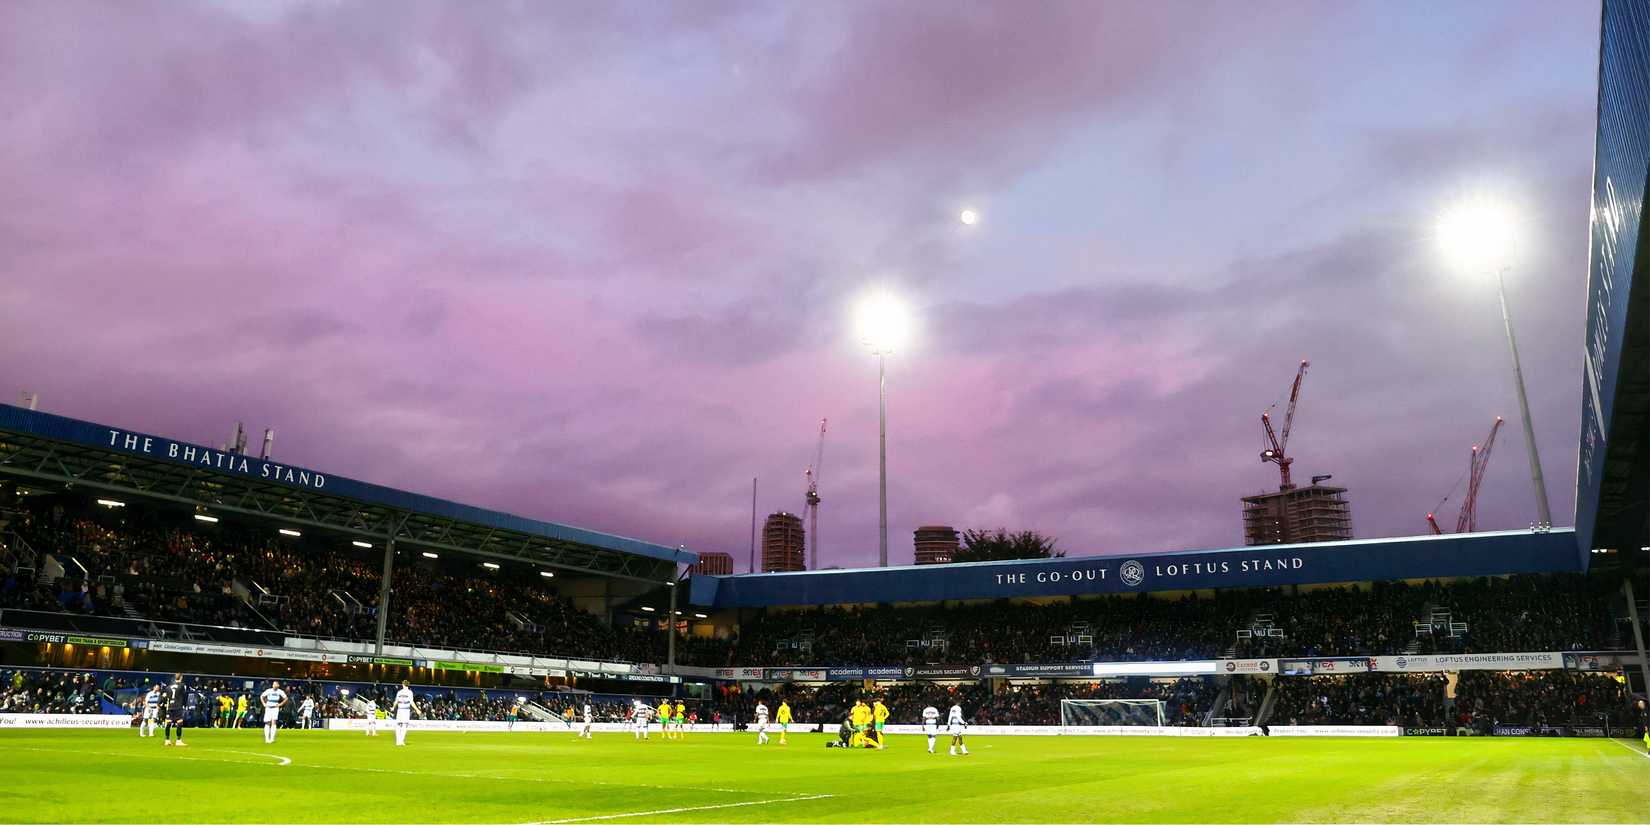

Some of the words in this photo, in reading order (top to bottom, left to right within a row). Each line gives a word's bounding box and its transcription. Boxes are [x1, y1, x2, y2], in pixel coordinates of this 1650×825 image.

[109, 430, 153, 453] THE
[168, 443, 249, 473] BHATIA
[261, 463, 326, 488] STAND
[996, 573, 1027, 585] THE
[1037, 568, 1109, 583] GO-OUT
[1156, 561, 1230, 577] LOFTUS
[1241, 558, 1304, 572] STAND
[868, 667, 902, 675] academia
